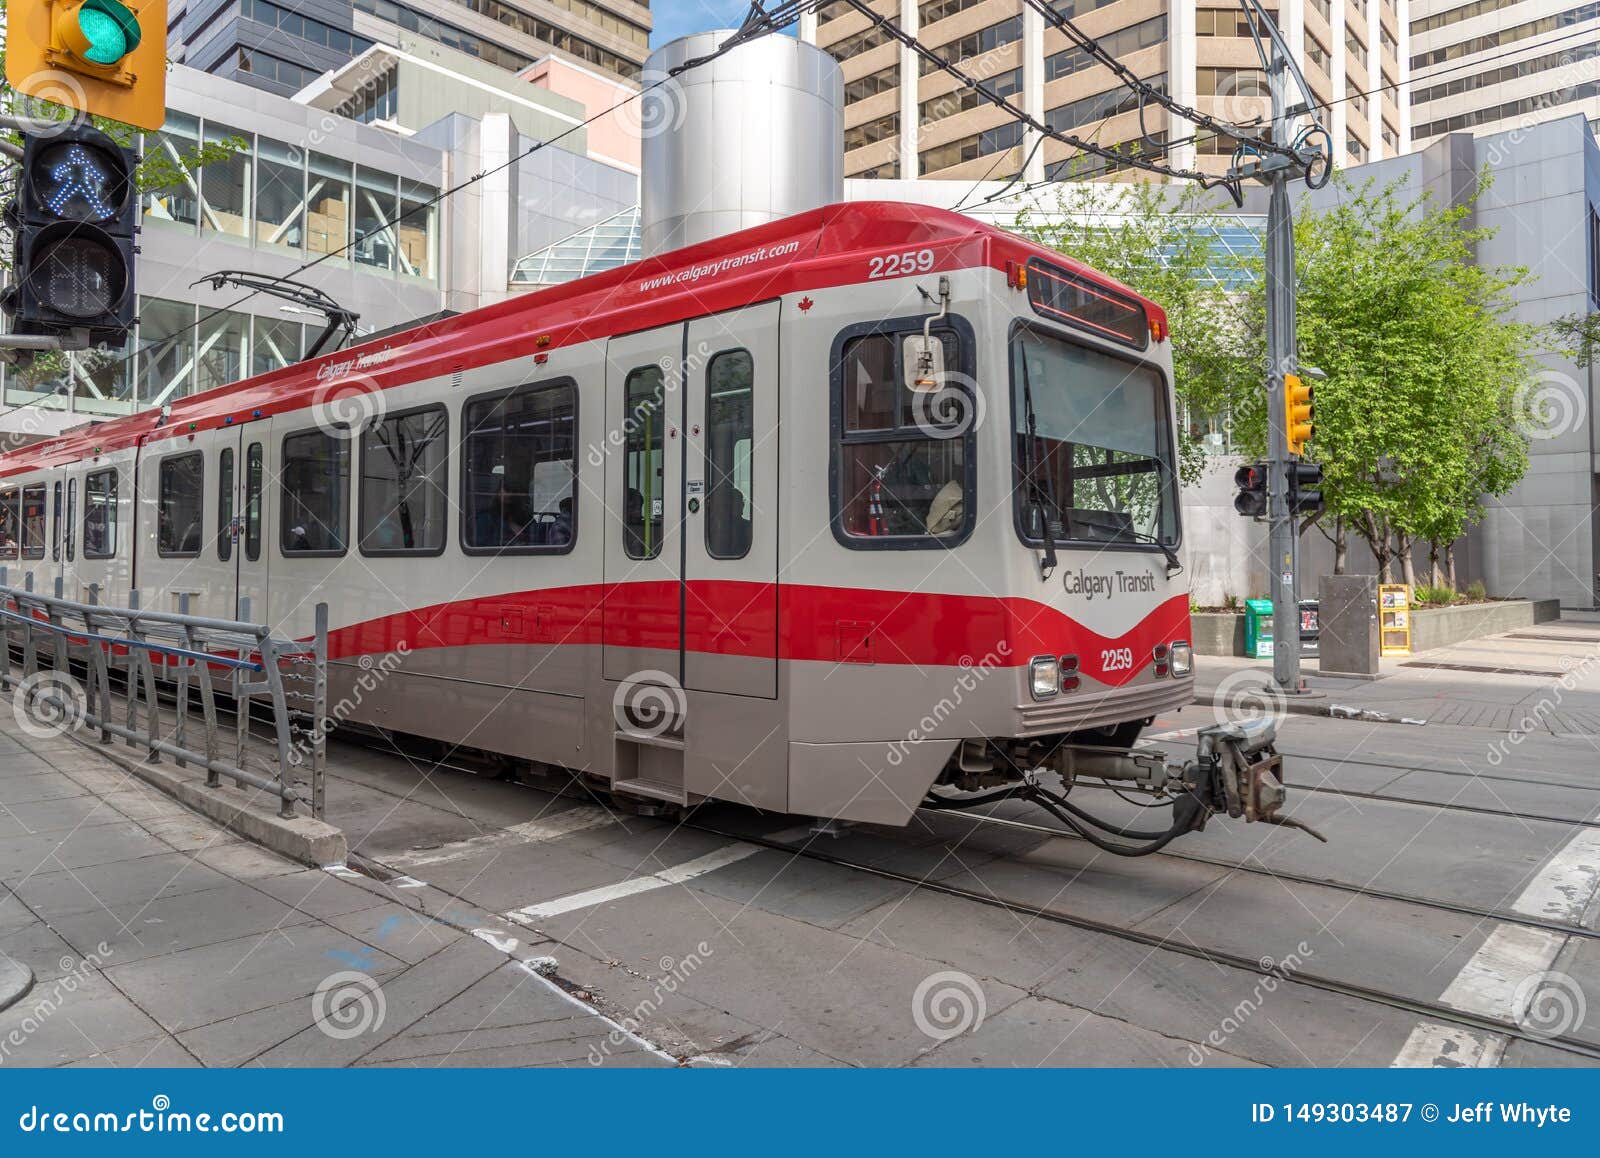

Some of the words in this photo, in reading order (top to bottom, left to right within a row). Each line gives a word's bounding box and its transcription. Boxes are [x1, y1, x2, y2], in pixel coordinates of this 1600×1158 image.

[639, 240, 799, 292] www.calgarytransit.com
[868, 248, 935, 279] 2259
[316, 359, 355, 381] Calgary
[1063, 568, 1113, 600] Calgary
[1115, 569, 1155, 593] Transit
[1101, 647, 1133, 672] 2259
